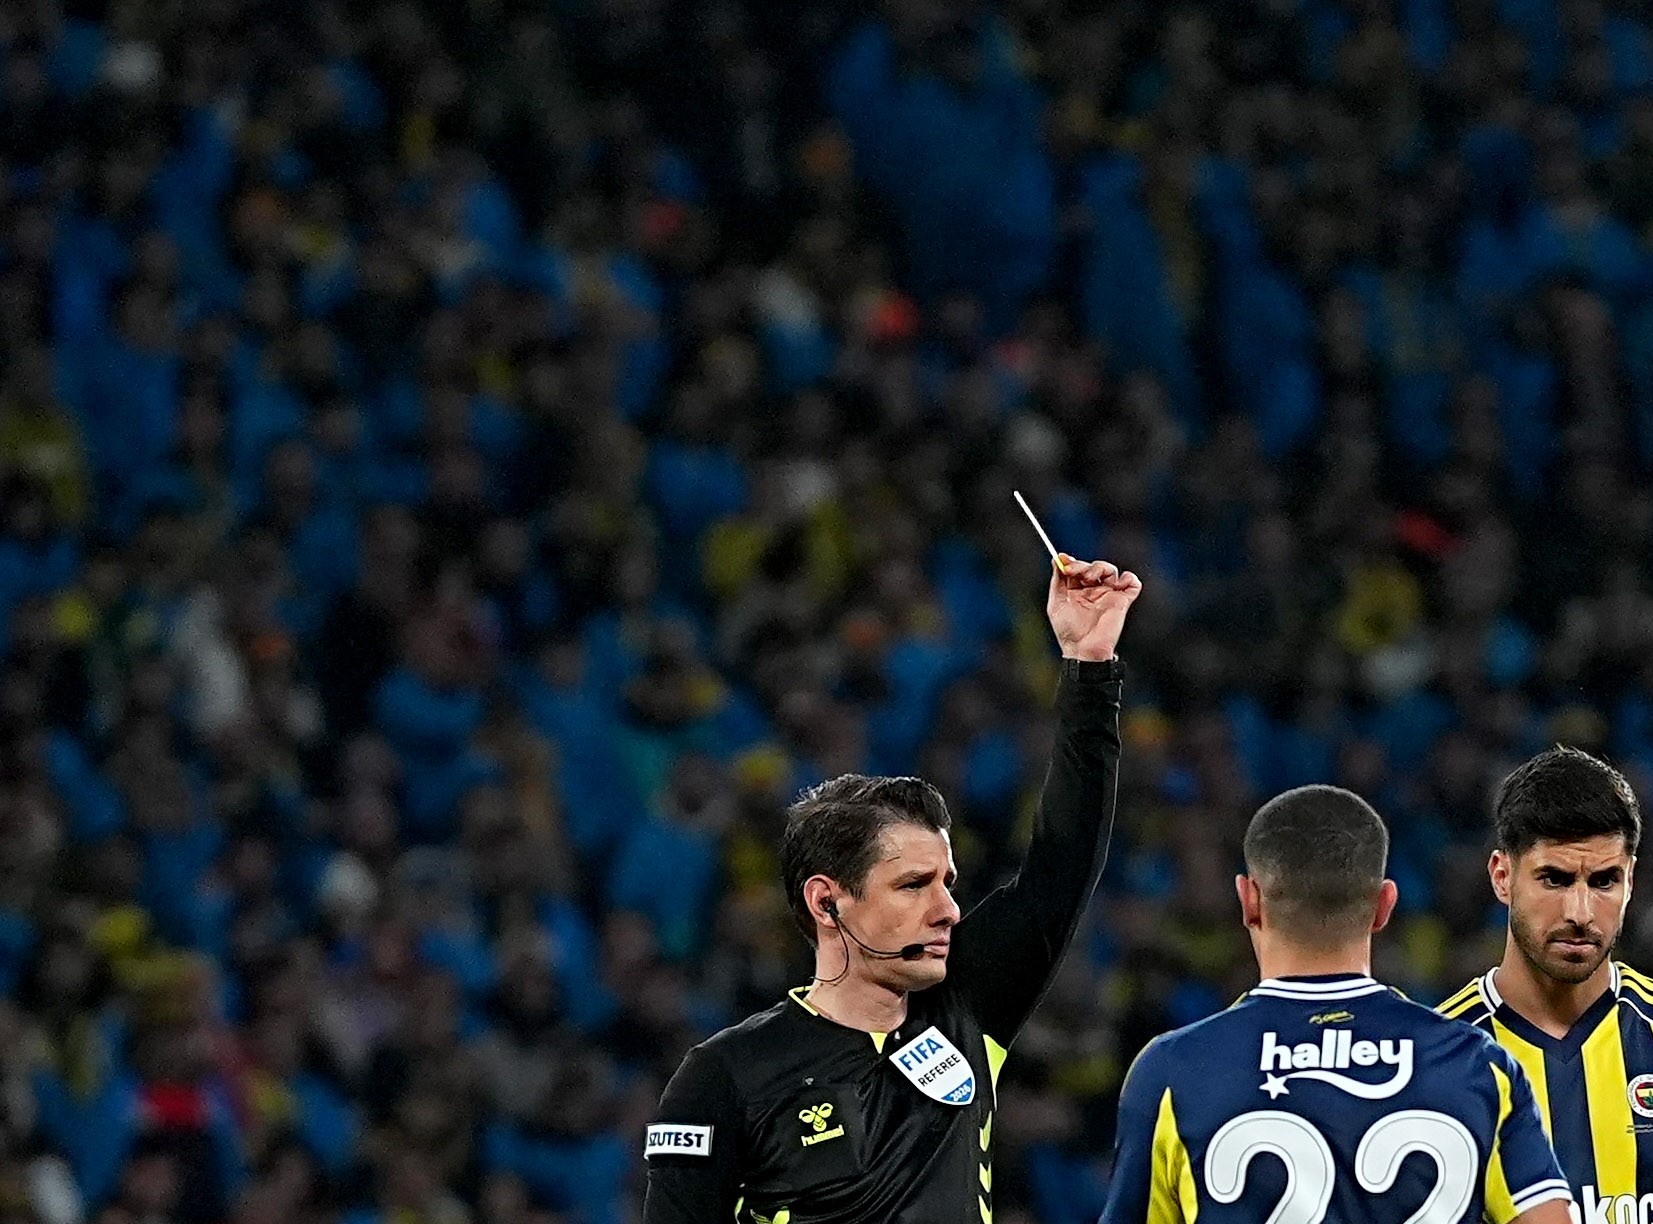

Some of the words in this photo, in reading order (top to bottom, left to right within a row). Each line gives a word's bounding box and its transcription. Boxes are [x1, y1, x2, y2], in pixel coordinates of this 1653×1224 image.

[898, 1037, 944, 1072] FIFA
[918, 1053, 961, 1087] REFEREE
[1260, 1028, 1414, 1100] halley
